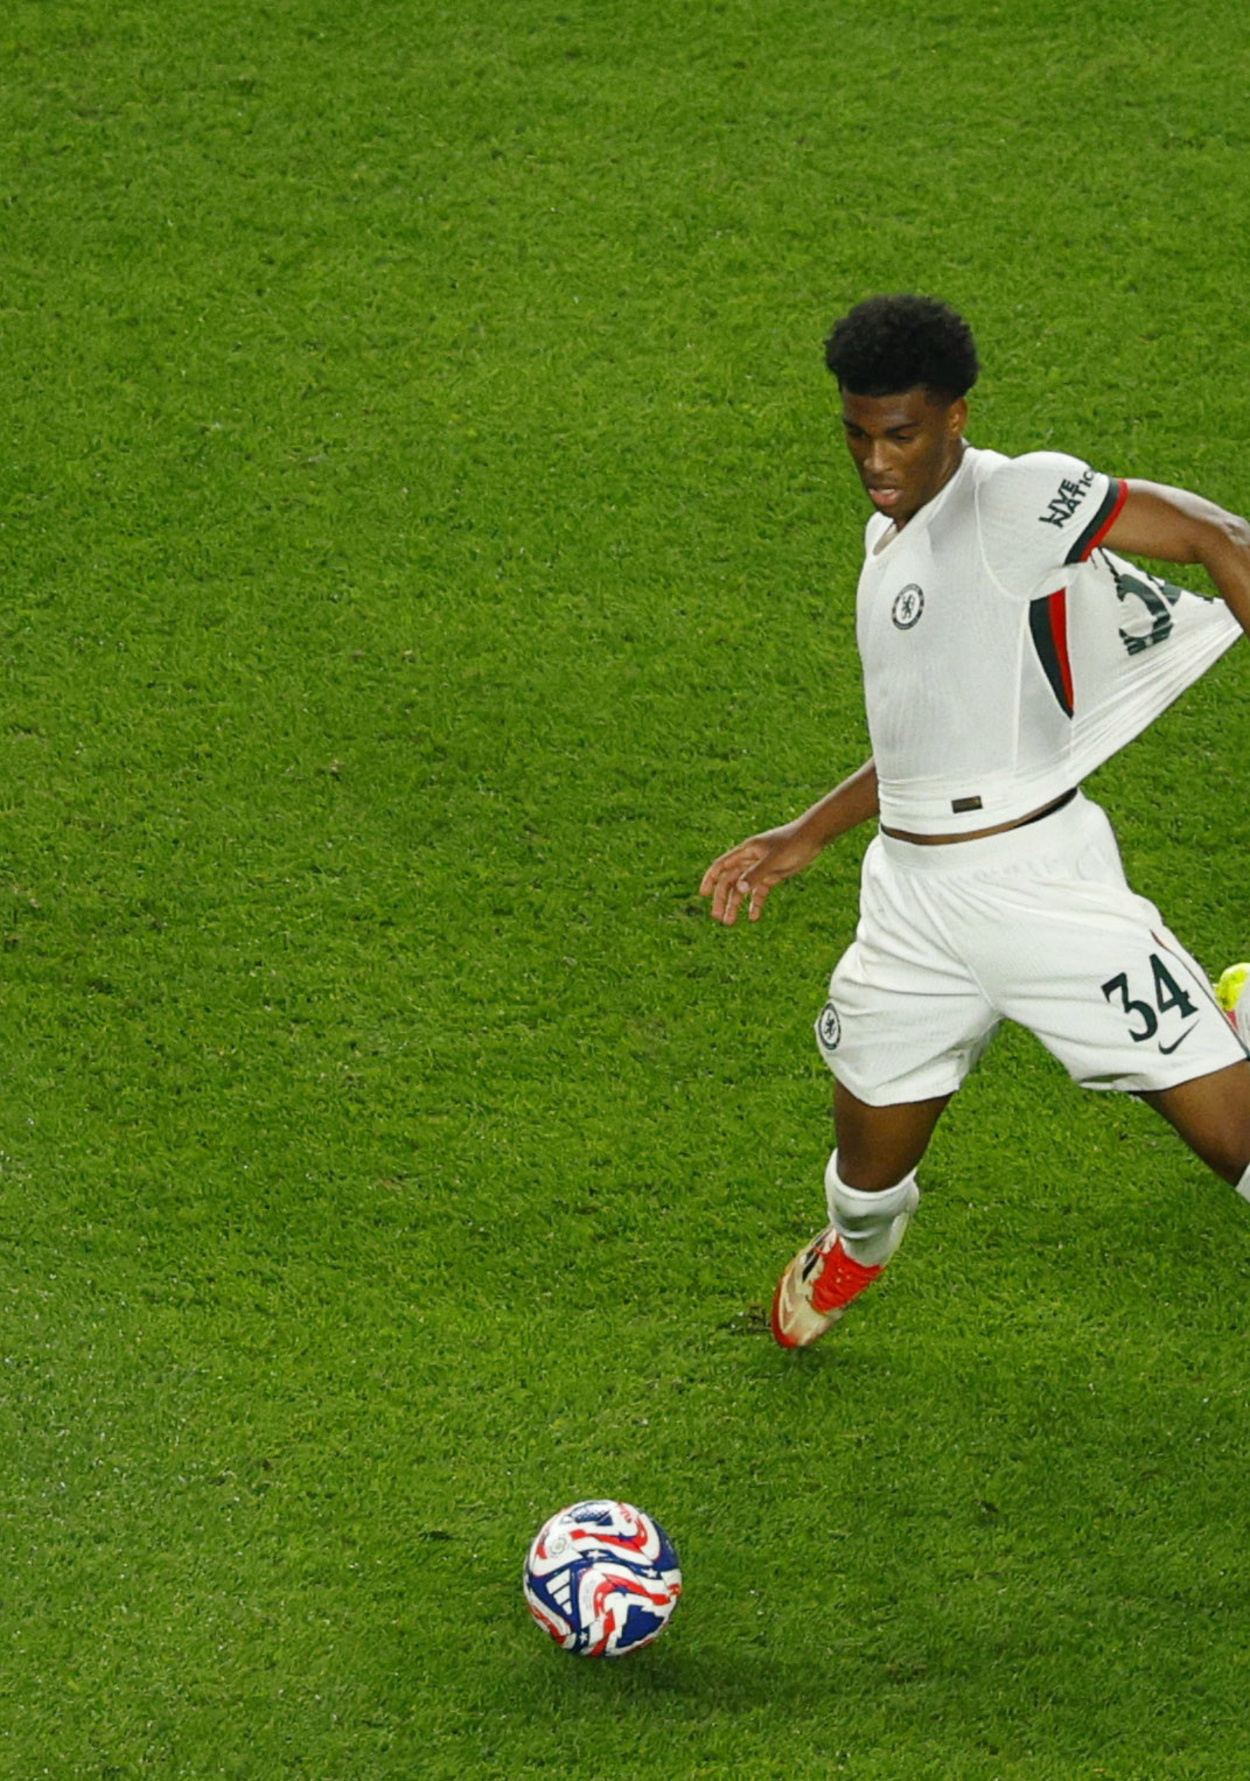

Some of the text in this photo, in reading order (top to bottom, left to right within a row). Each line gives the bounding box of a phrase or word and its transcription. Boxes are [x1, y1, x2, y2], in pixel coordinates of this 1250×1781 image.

[1038, 478, 1076, 523] LIVE
[1052, 470, 1095, 528] NATIO
[1101, 953, 1199, 1042] 34
